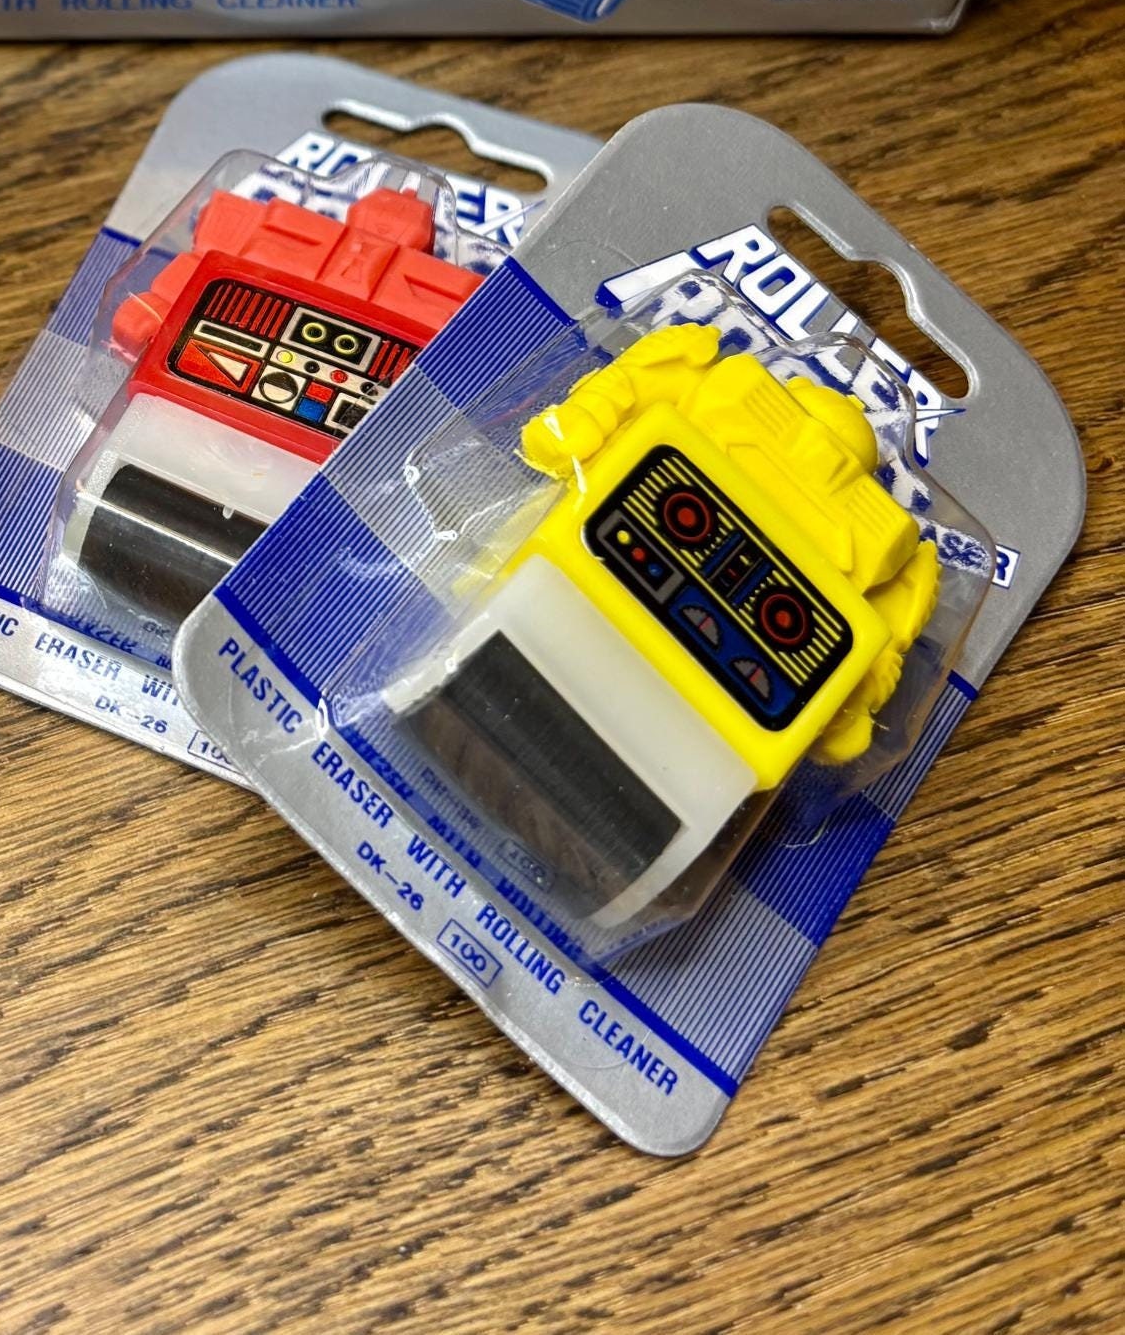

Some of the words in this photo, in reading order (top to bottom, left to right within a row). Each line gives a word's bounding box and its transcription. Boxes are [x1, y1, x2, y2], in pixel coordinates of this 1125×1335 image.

[34, 631, 123, 682] ERASER
[95, 695, 169, 735] DK-26
[200, 740, 232, 765] 10
[217, 637, 304, 735] PLASTIC
[311, 741, 395, 829] ERASER
[406, 834, 467, 899] WITH
[476, 902, 566, 996] ROLLING
[577, 999, 679, 1096] CLEANER
[357, 840, 425, 912] DK-26
[451, 932, 489, 973] 100
